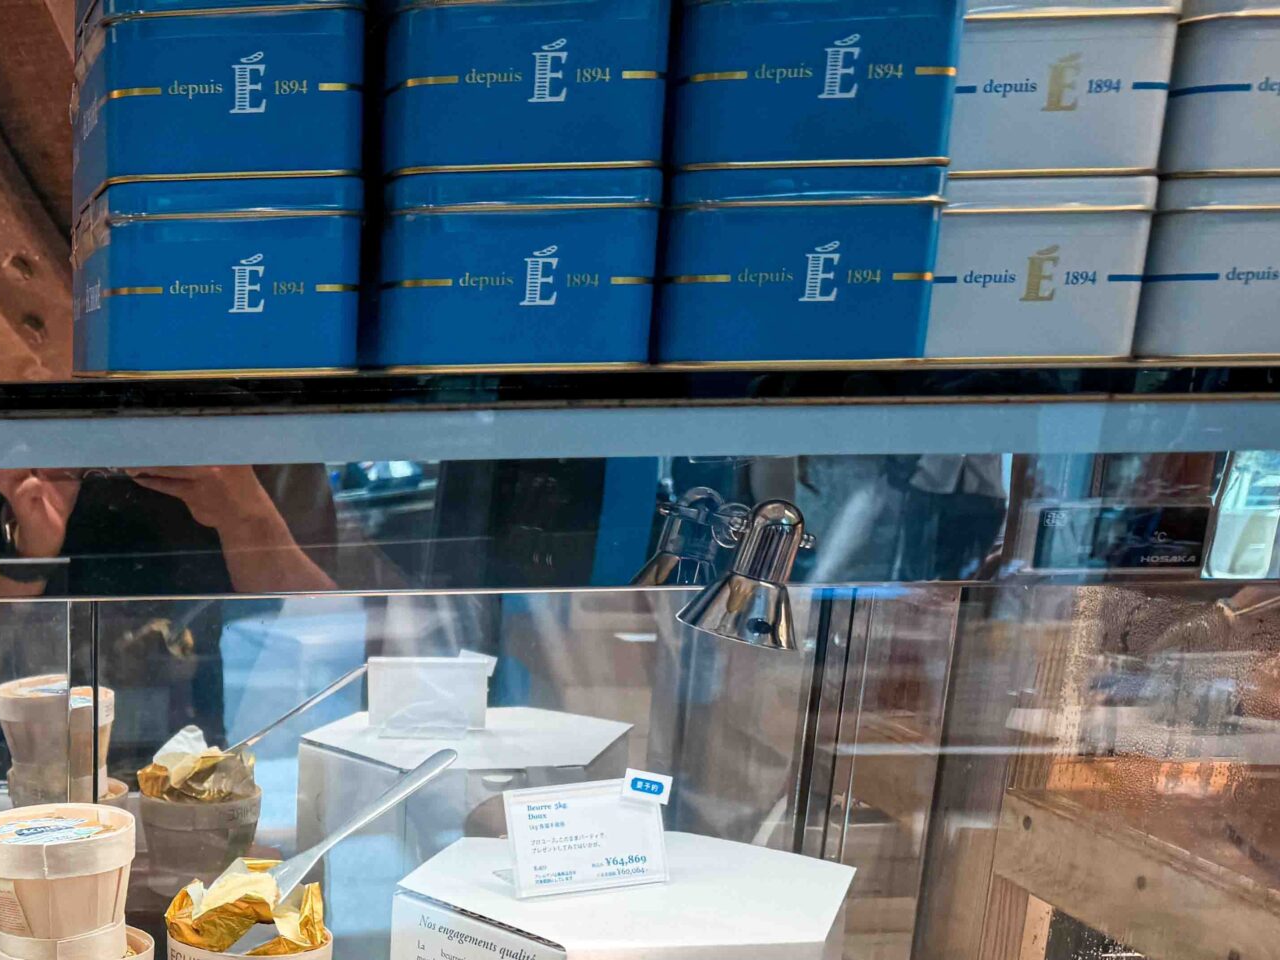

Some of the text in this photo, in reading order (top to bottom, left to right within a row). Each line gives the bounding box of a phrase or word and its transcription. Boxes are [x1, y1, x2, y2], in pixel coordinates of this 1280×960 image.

[168, 51, 307, 113] depuis É 1894
[466, 38, 610, 102] depuis É 1894
[754, 33, 903, 100] depuis É 1894
[982, 52, 1121, 112] depuis É 1894
[169, 253, 305, 313] depuis É 1894
[459, 245, 600, 306] depuis É 1894
[738, 241, 881, 302] depuis É 1894
[963, 245, 1097, 302] depuis É 1894
[1225, 267, 1280, 286] depuis
[605, 854, 647, 867] ¥64,869
[419, 914, 436, 930] Nos
[438, 924, 497, 952] engagements
